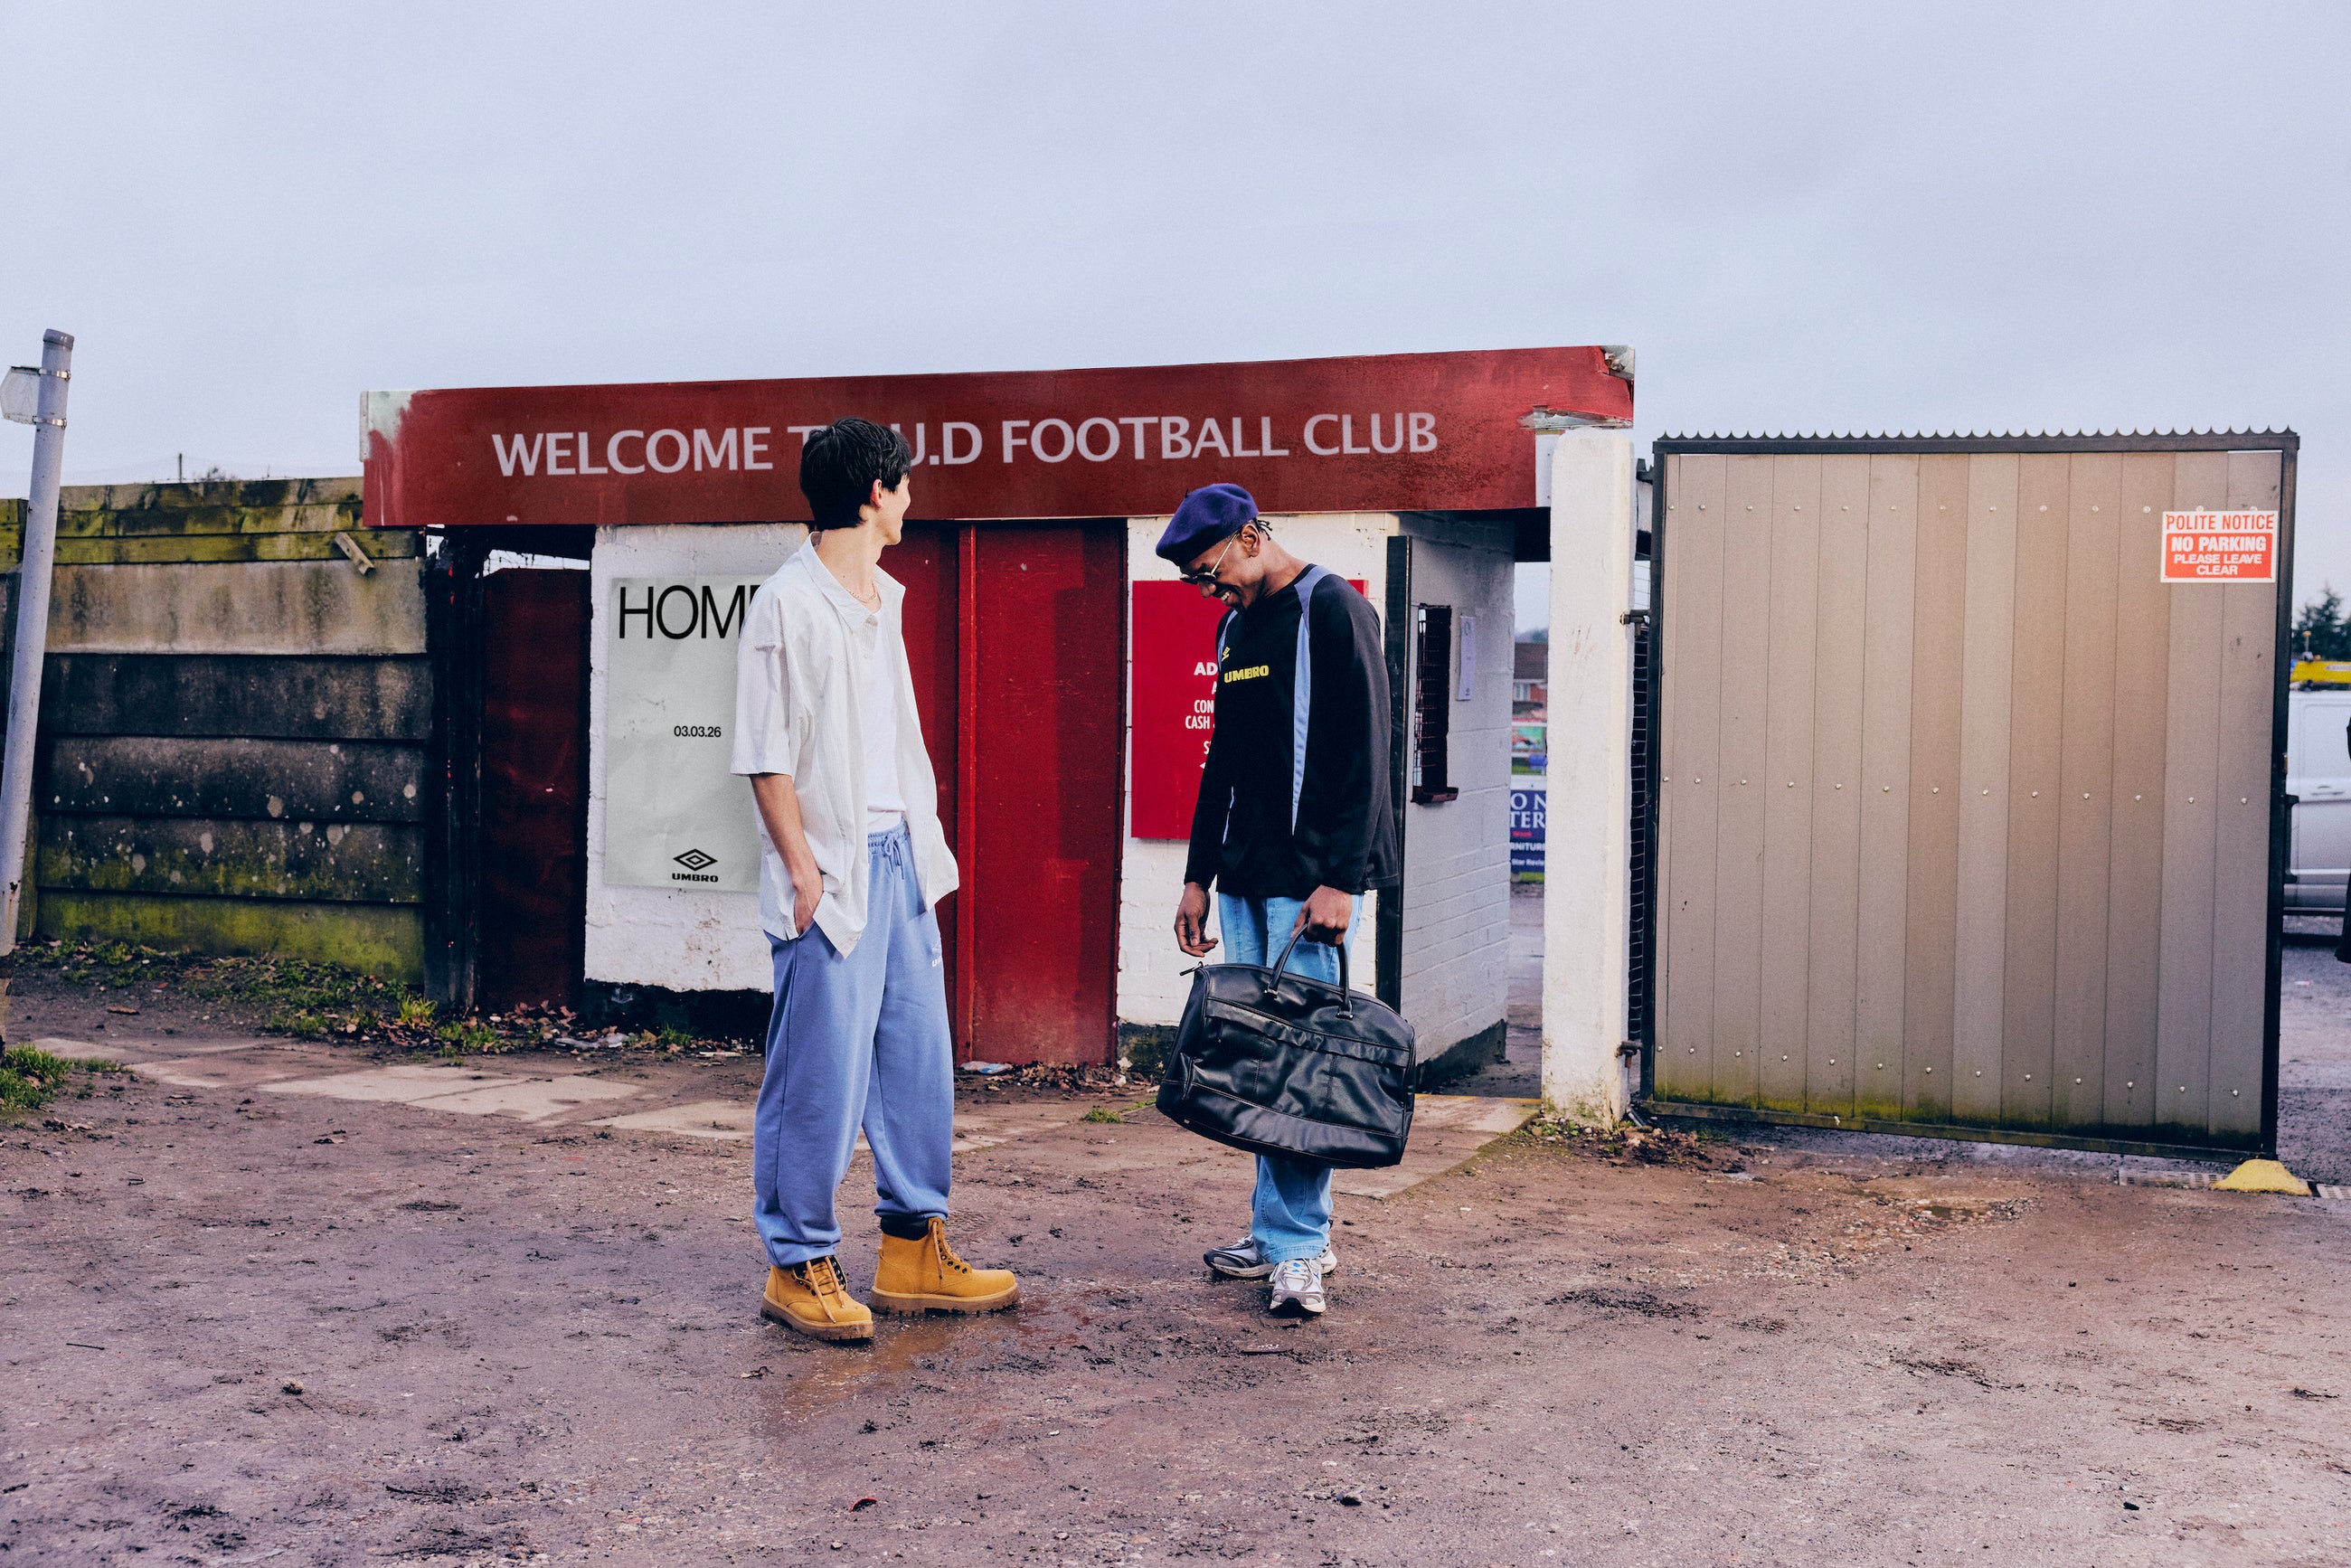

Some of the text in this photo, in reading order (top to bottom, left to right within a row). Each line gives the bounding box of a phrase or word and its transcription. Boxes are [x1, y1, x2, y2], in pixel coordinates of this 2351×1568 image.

[492, 427, 773, 477] WELCOME
[1001, 416, 1289, 463] FOOTBALL
[1303, 412, 1438, 455] CLUB
[2167, 514, 2274, 530] POLITE NOTICE
[2171, 536, 2267, 552] NO PARKING
[2174, 553, 2262, 564] PLEASE LEAVE
[2196, 565, 2238, 575] CLEAR
[619, 584, 761, 639] HOM
[1194, 662, 1218, 675] AD
[1224, 665, 1270, 684] UMBRO
[1194, 699, 1214, 713] CON
[1185, 715, 1211, 730] CASH
[674, 725, 722, 738] 03.03.26
[672, 873, 719, 883] UMBRO
